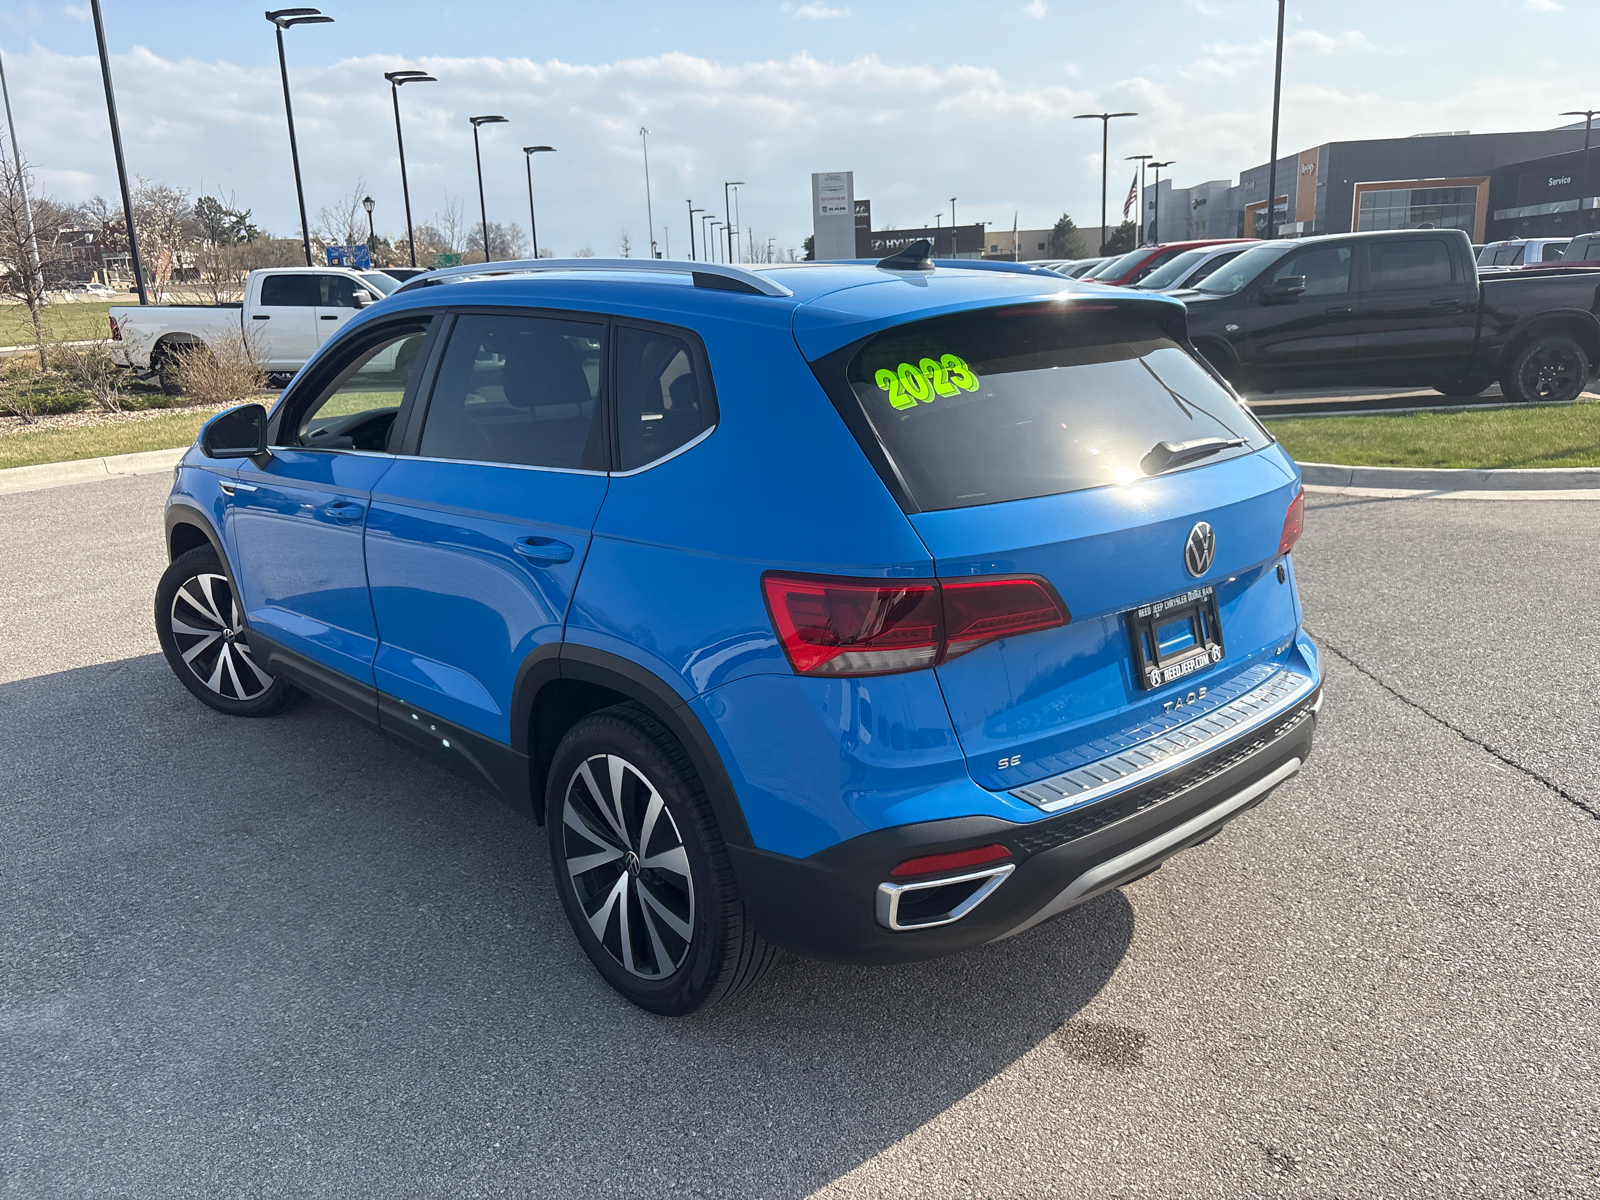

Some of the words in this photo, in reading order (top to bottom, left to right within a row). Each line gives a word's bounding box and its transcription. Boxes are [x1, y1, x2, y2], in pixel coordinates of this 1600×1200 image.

[1548, 175, 1571, 187] Service
[875, 354, 980, 411] 2023
[1138, 606, 1152, 618] REED
[1152, 602, 1164, 614] JEEP
[1164, 594, 1188, 610] CHRYSLER
[1202, 585, 1213, 598] RAM
[1164, 654, 1210, 681] REEDJEEP.COM
[1163, 687, 1207, 714] TAOS
[997, 754, 1021, 769] SE
